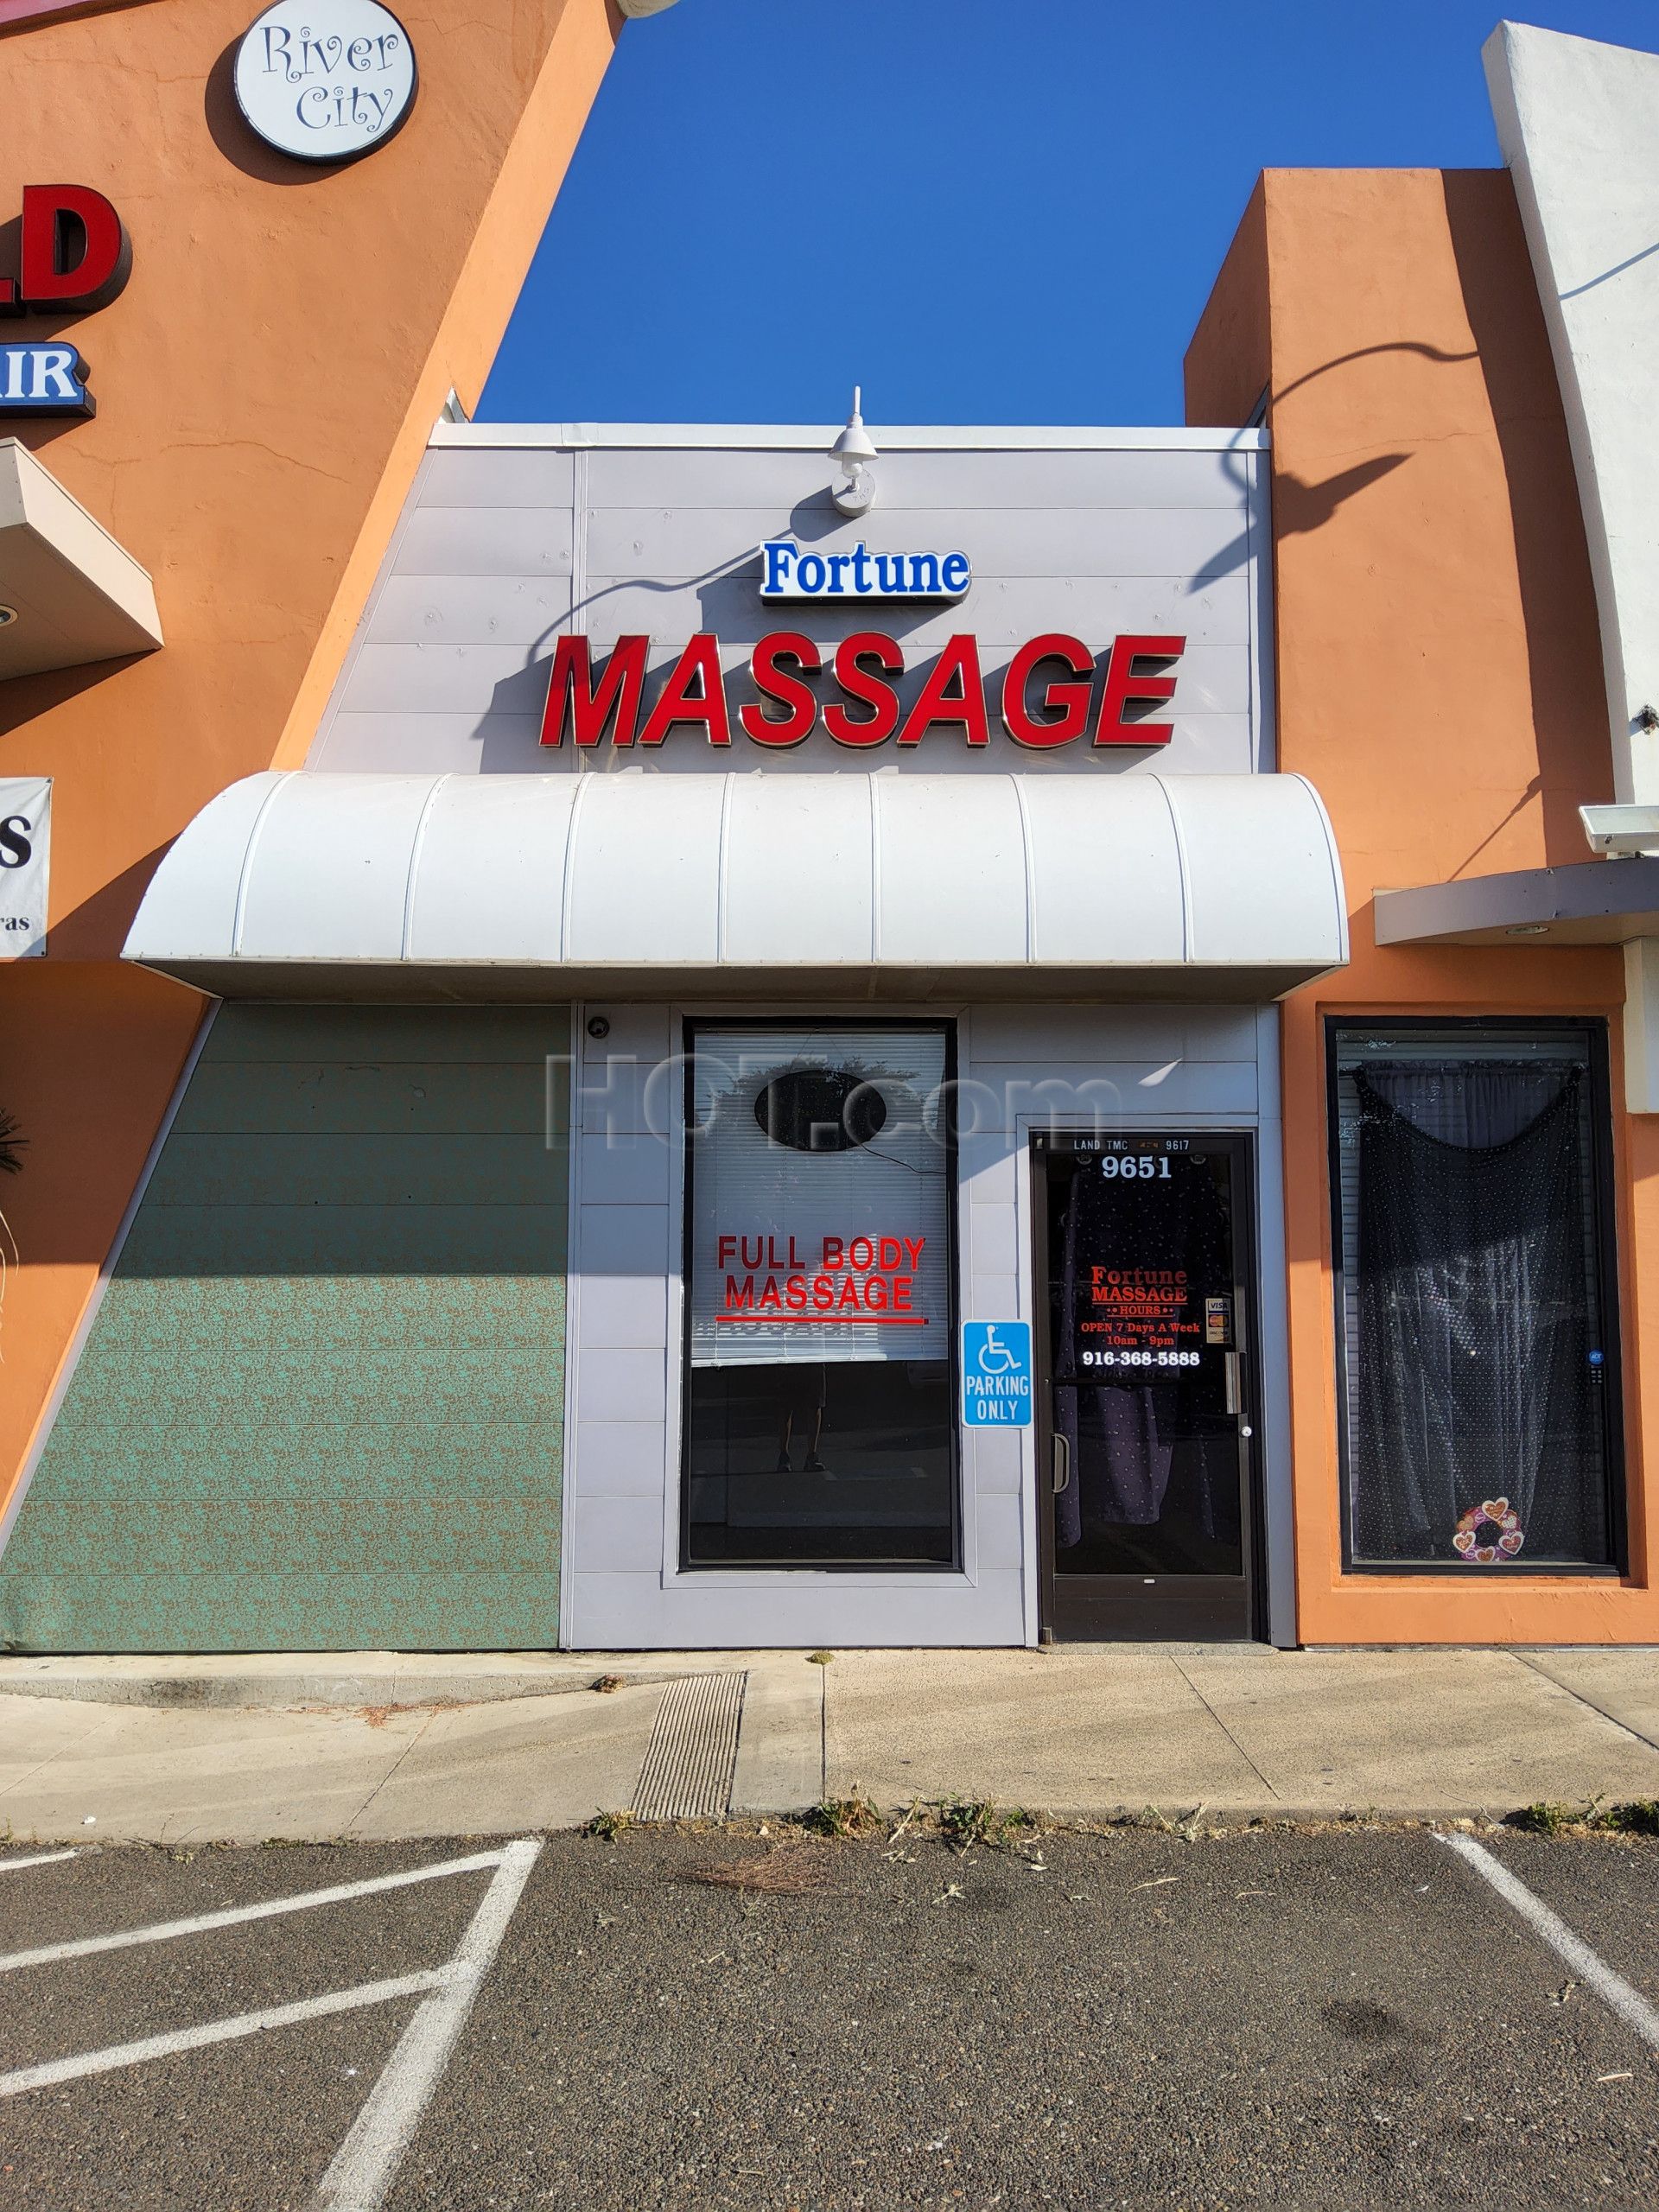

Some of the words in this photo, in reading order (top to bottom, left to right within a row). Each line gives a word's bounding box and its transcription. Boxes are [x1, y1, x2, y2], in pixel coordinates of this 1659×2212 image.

[261, 25, 398, 82] River
[296, 86, 393, 132] City
[0, 184, 122, 302] D
[0, 351, 78, 398] IR
[764, 543, 969, 594] Fortune
[538, 631, 1187, 749] MASSAGE
[1074, 1140, 1101, 1150] LAND
[1107, 1140, 1128, 1150] TMC
[1166, 1140, 1190, 1150] 9617
[1102, 1156, 1172, 1179] 9651
[718, 1236, 805, 1269] FULL
[823, 1236, 926, 1271] BODY
[1091, 1266, 1187, 1285] Fortune
[726, 1274, 912, 1310] MASSAGE
[1091, 1287, 1188, 1301] MASSAGE
[1119, 1306, 1161, 1315] HOURS
[1081, 1323, 1113, 1332] OPEN
[1116, 1323, 1123, 1332] 7
[1127, 1323, 1155, 1334] Days
[1158, 1323, 1167, 1332] A
[1170, 1323, 1200, 1332] Week
[1107, 1335, 1138, 1345] 10am
[1149, 1335, 1174, 1347] 9pm
[1083, 1351, 1200, 1366] 916-368-5888
[966, 1376, 1029, 1396] PARKING
[977, 1400, 1018, 1421] ONLY
